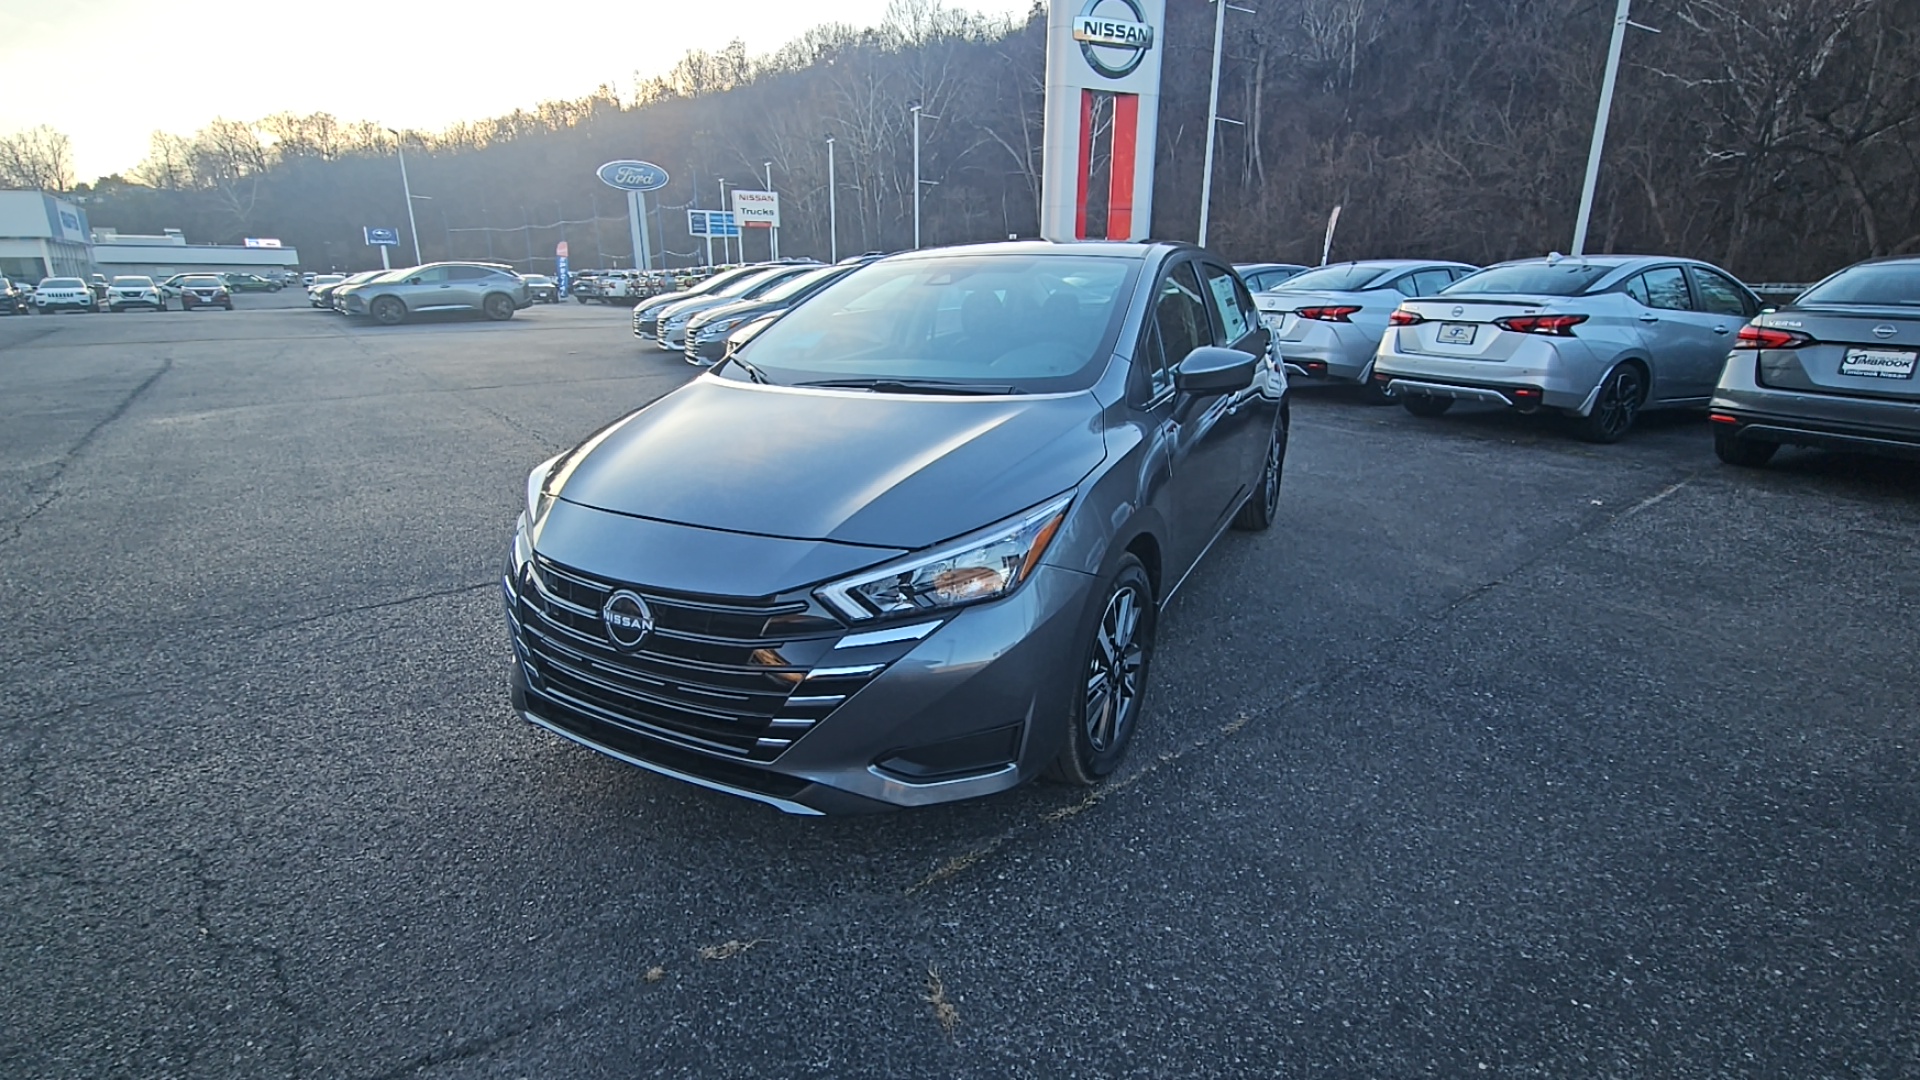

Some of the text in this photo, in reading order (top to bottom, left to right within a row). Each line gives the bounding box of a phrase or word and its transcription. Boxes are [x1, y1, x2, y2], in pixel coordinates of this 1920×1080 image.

[1084, 21, 1148, 41] NISSAN
[615, 166, 654, 184] Ford
[738, 193, 774, 202] NISSAN
[740, 207, 774, 216] Trucks
[603, 609, 653, 630] NISSAN
